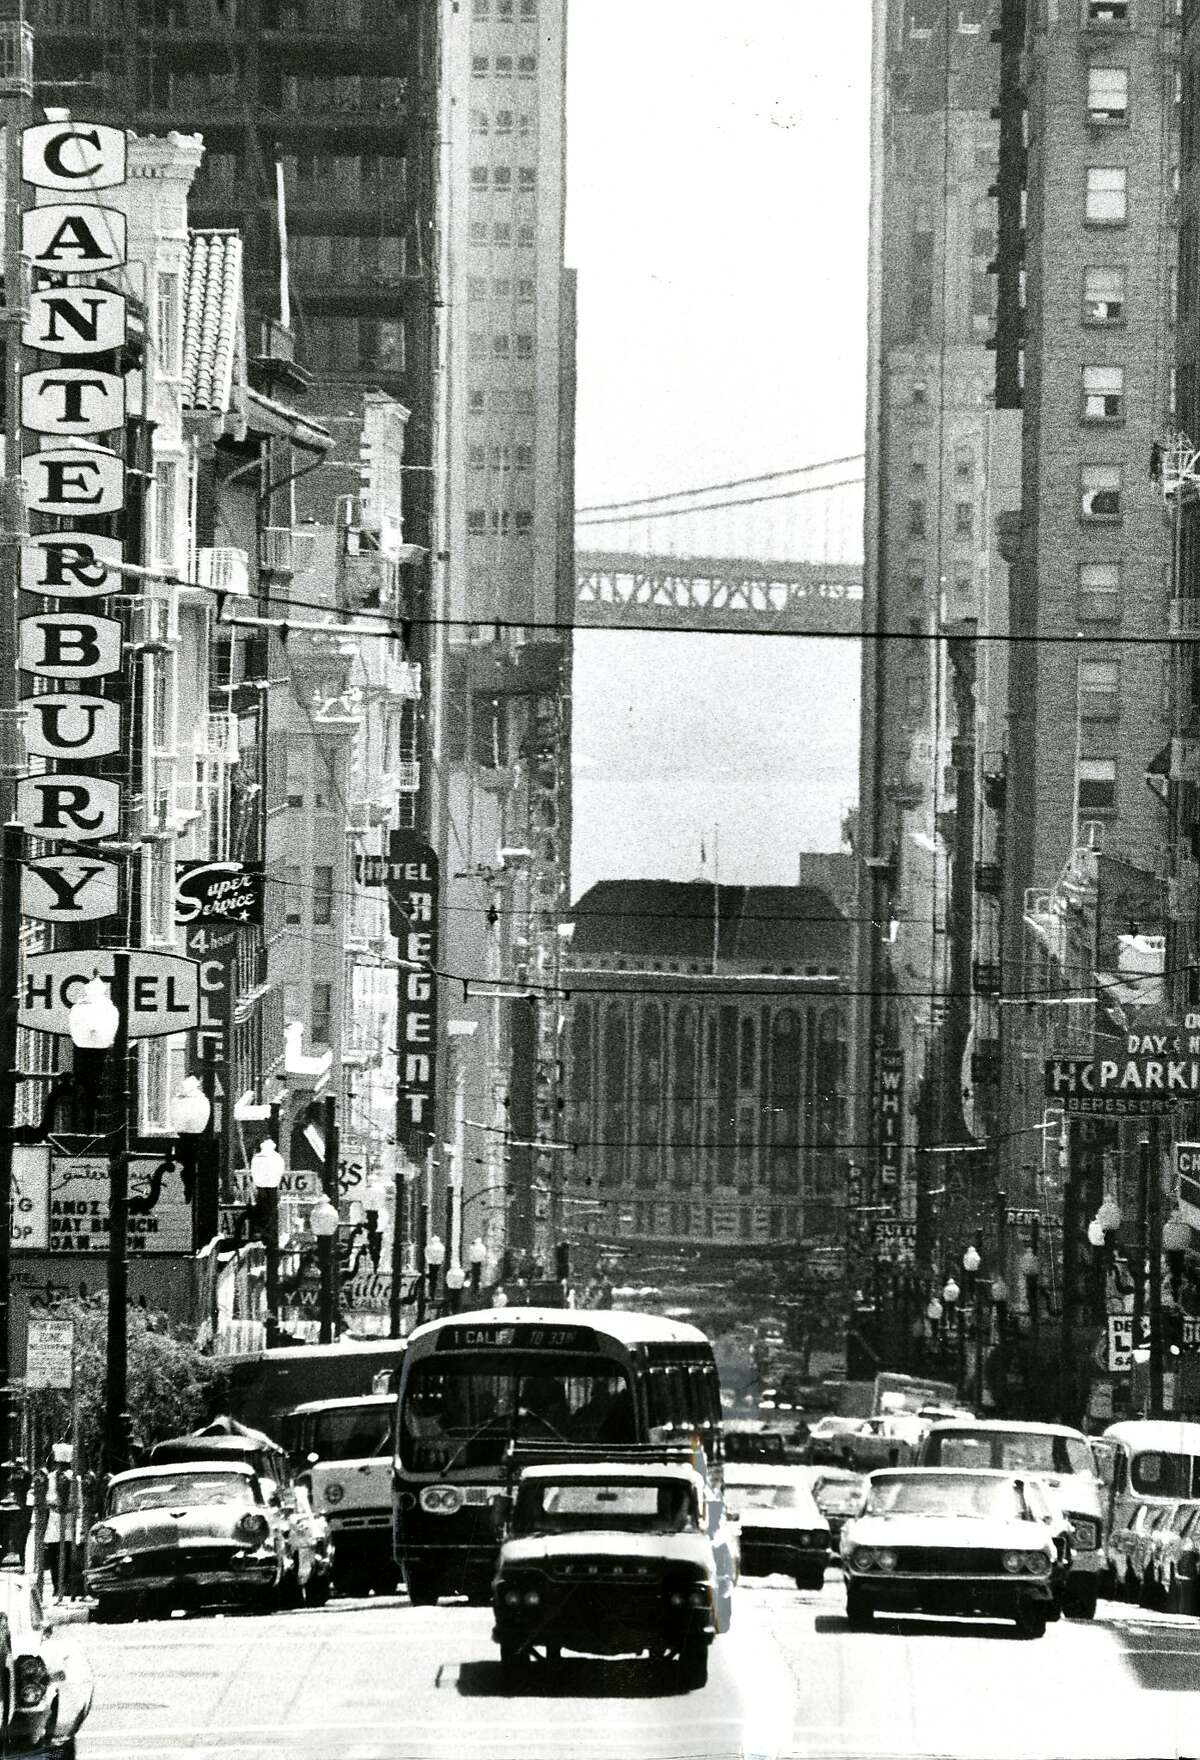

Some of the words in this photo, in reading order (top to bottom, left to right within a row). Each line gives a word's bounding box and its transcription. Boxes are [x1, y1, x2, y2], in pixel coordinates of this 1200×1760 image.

[28, 130, 113, 911] CANTERBURY
[360, 862, 432, 881] HOTEL
[25, 974, 190, 1013] HOEL
[405, 892, 433, 1122] REGENT
[1128, 1034, 1167, 1054] DAY
[1100, 1060, 1199, 1089] PARKI
[882, 1071, 900, 1184] WHITE
